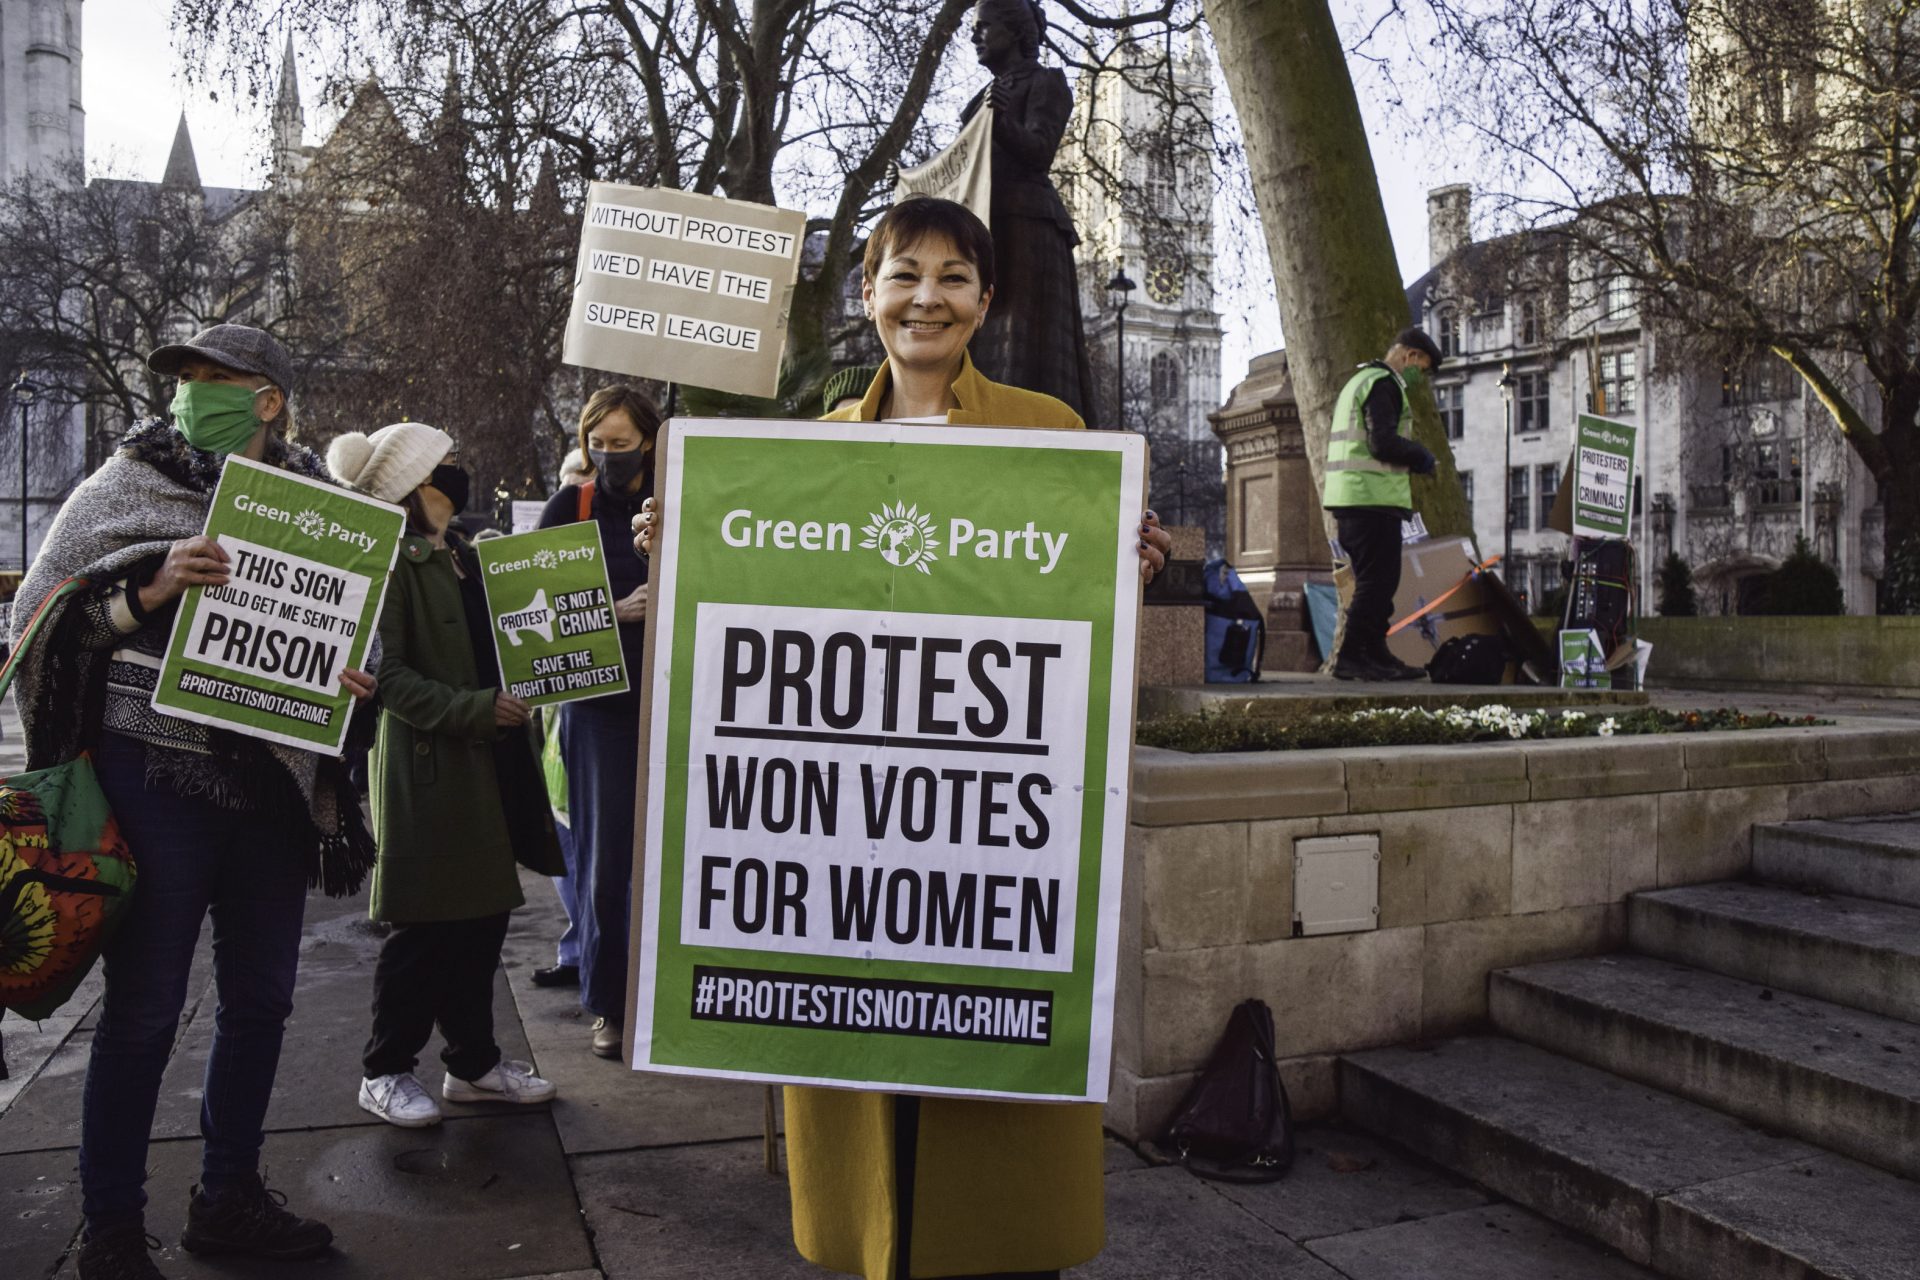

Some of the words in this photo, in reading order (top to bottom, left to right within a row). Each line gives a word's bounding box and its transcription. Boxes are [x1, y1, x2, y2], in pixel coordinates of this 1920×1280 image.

[591, 205, 680, 235] WITHOUT
[685, 220, 792, 254] PROTEST
[592, 253, 641, 276] WE'D
[651, 262, 710, 290] HAVE
[724, 274, 768, 299] THE
[587, 303, 655, 331] SUPER
[667, 317, 757, 350] LEAGUE
[1582, 450, 1628, 472] PROTESTERS
[1594, 472, 1609, 486] NOT
[1580, 486, 1625, 510] CRIMINALS
[234, 494, 291, 524] Green
[328, 522, 377, 553] Party
[720, 509, 851, 553] Green
[948, 518, 1069, 574] Party
[234, 550, 288, 589] THIS
[290, 567, 346, 606] SIGN
[488, 558, 531, 575] Green
[558, 546, 595, 562] Party
[204, 584, 249, 608] COULD
[250, 594, 278, 617] GET
[278, 602, 301, 622] ME
[302, 609, 338, 631] SENT
[340, 620, 356, 637] TO
[500, 609, 549, 631] PROTEST
[555, 596, 566, 612] IS
[570, 591, 593, 609] NOT
[597, 589, 607, 605] A
[558, 608, 612, 636] CRIME
[197, 612, 338, 687] PRISON
[533, 656, 565, 676] SAVE
[567, 651, 592, 669] THE
[180, 673, 330, 726] #PROTESTISNOTACRIME
[511, 679, 547, 699] RIGHT
[548, 674, 565, 693] TO
[567, 666, 620, 690] PROTEST
[719, 627, 1062, 741] PROTEST
[705, 754, 840, 837] WON
[860, 763, 1053, 850] VOTES
[698, 855, 809, 938] FOR
[829, 864, 1061, 955] WOMEN
[695, 975, 1050, 1041] #PROTESTISNOTACRIME
